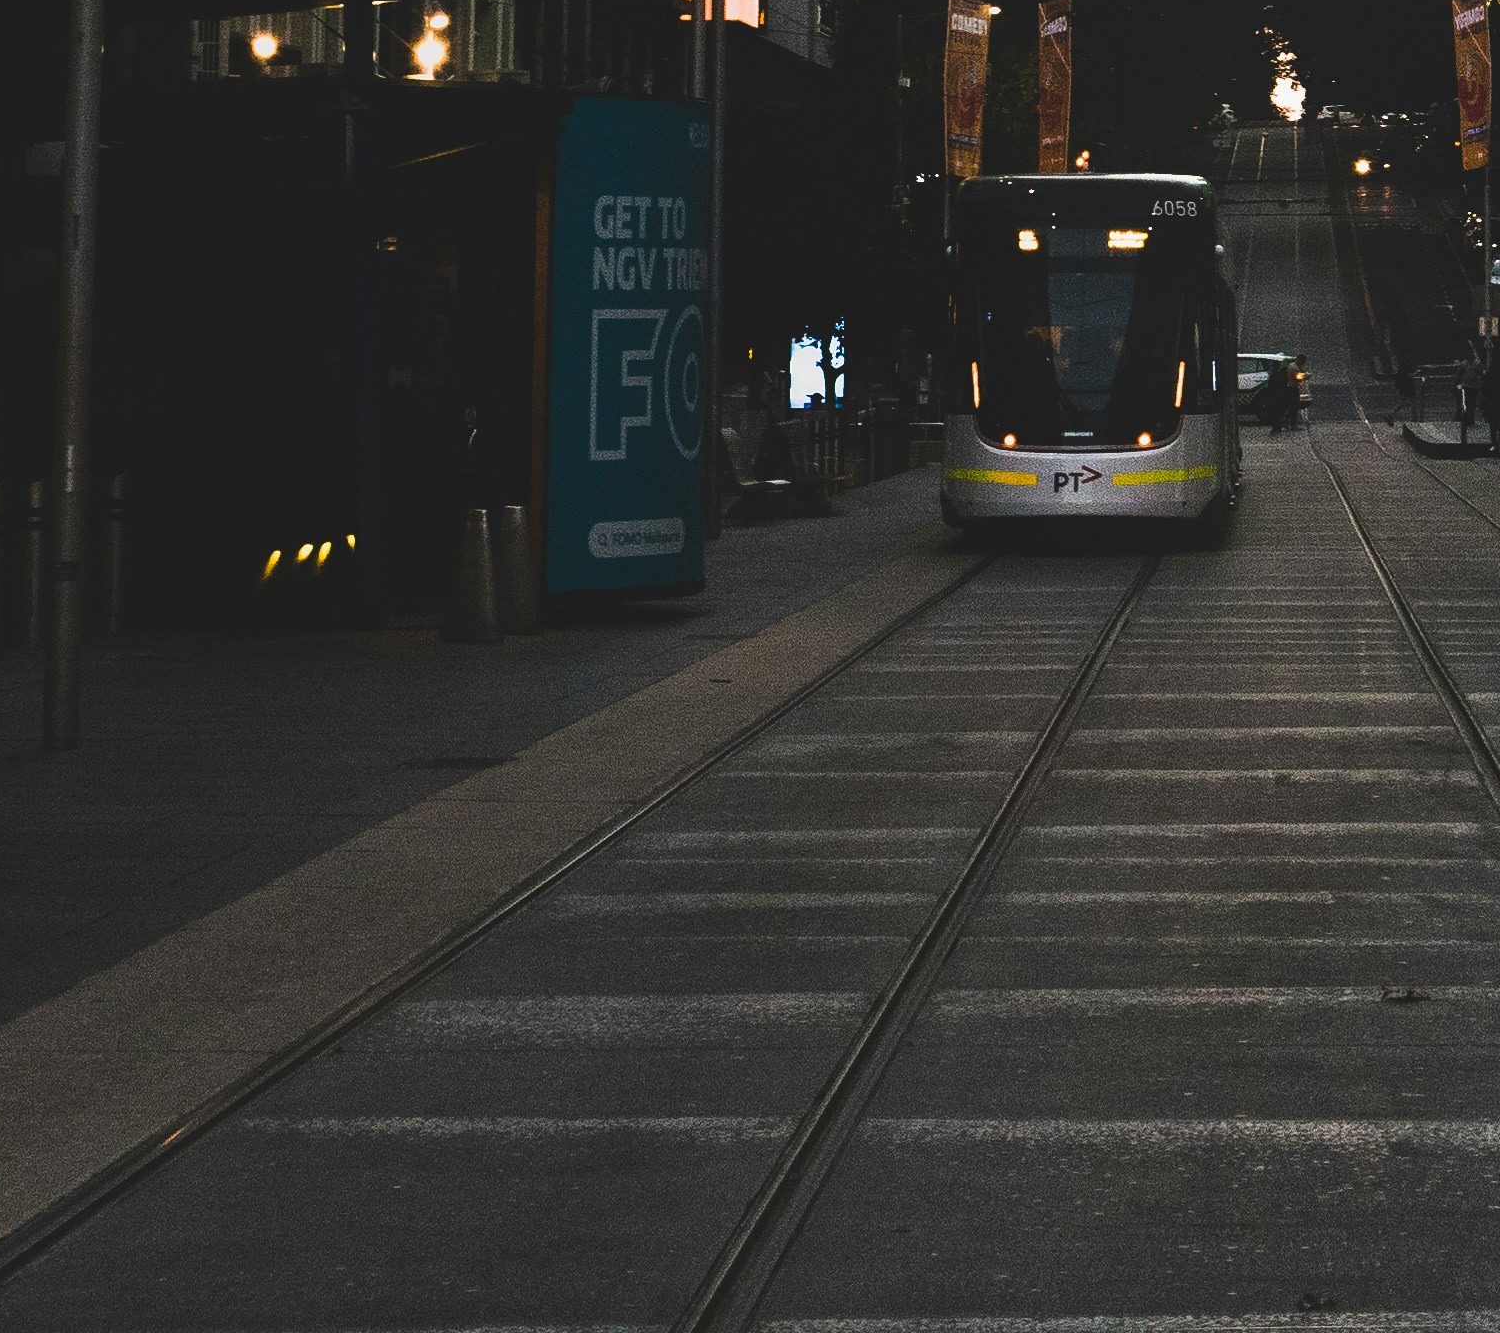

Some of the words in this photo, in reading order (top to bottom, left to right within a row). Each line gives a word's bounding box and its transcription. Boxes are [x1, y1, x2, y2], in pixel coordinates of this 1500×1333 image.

[593, 194, 652, 239] GET
[657, 196, 687, 240] TO
[1152, 199, 1198, 217] 6058
[592, 246, 658, 291] NGV
